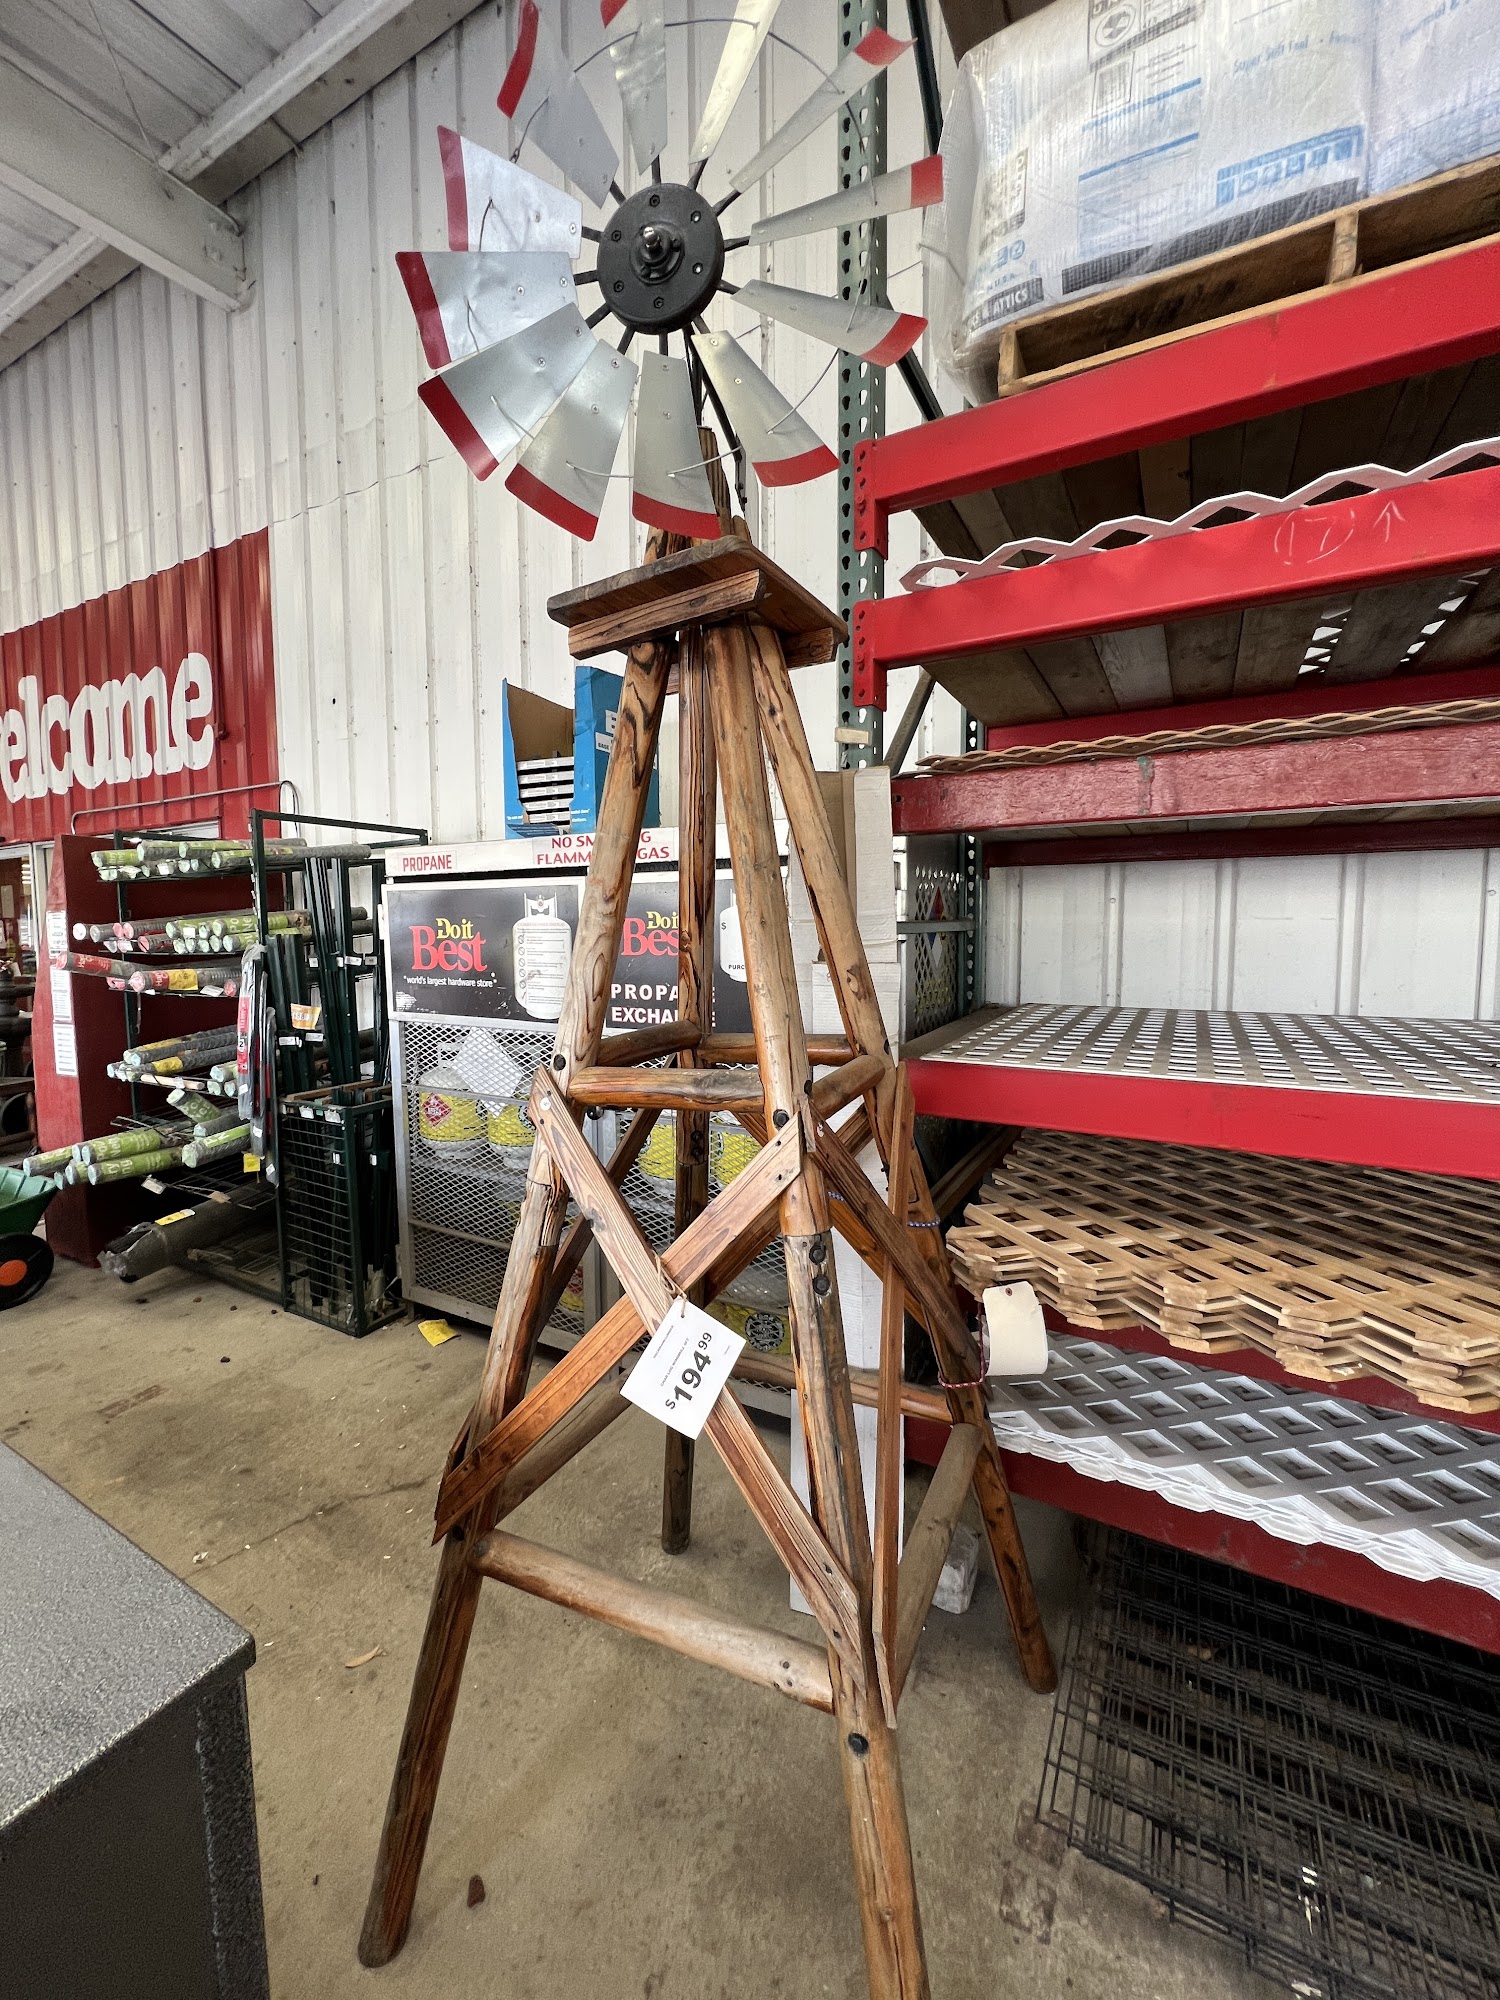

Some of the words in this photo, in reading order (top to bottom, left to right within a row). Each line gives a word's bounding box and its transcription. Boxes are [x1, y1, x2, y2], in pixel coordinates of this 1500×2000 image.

[0, 653, 214, 803] elcome
[551, 836, 572, 849] NO
[403, 854, 452, 872] PROPANE
[537, 853, 592, 865] FLAMM
[637, 846, 670, 860] GAS
[621, 917, 679, 956] Bes
[409, 925, 487, 972] Best
[610, 983, 716, 1003] PROPA
